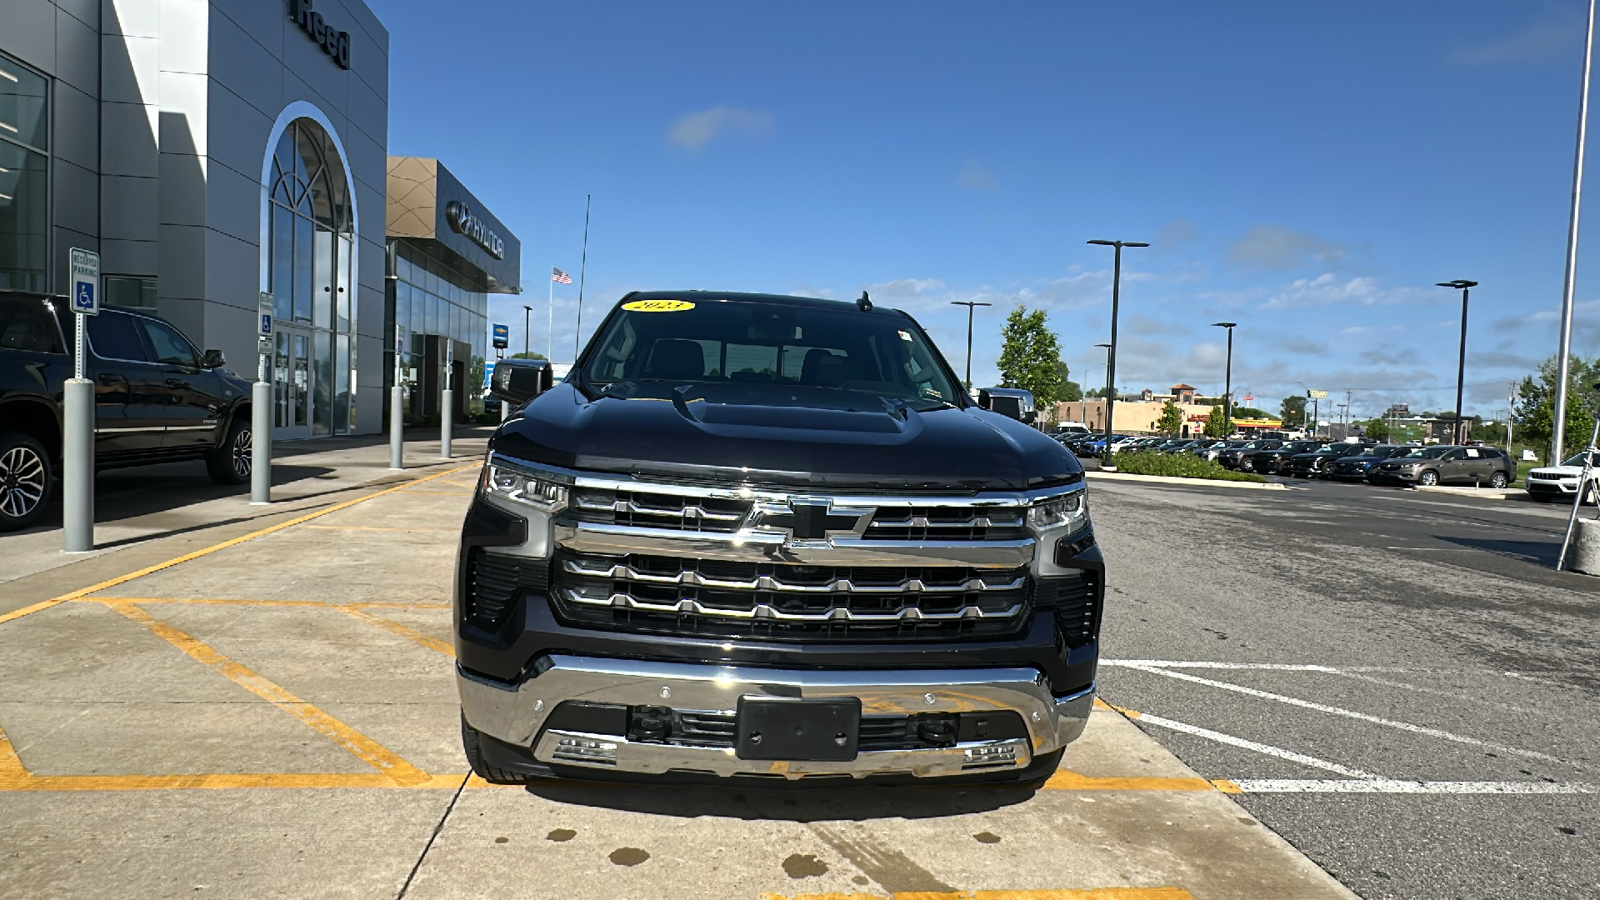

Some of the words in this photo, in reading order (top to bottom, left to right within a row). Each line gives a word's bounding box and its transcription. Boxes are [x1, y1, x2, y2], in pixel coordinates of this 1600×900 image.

[289, 0, 350, 70] Reed
[73, 254, 97, 267] RESERVED
[73, 265, 97, 278] PARKING
[633, 301, 685, 310] 2023
